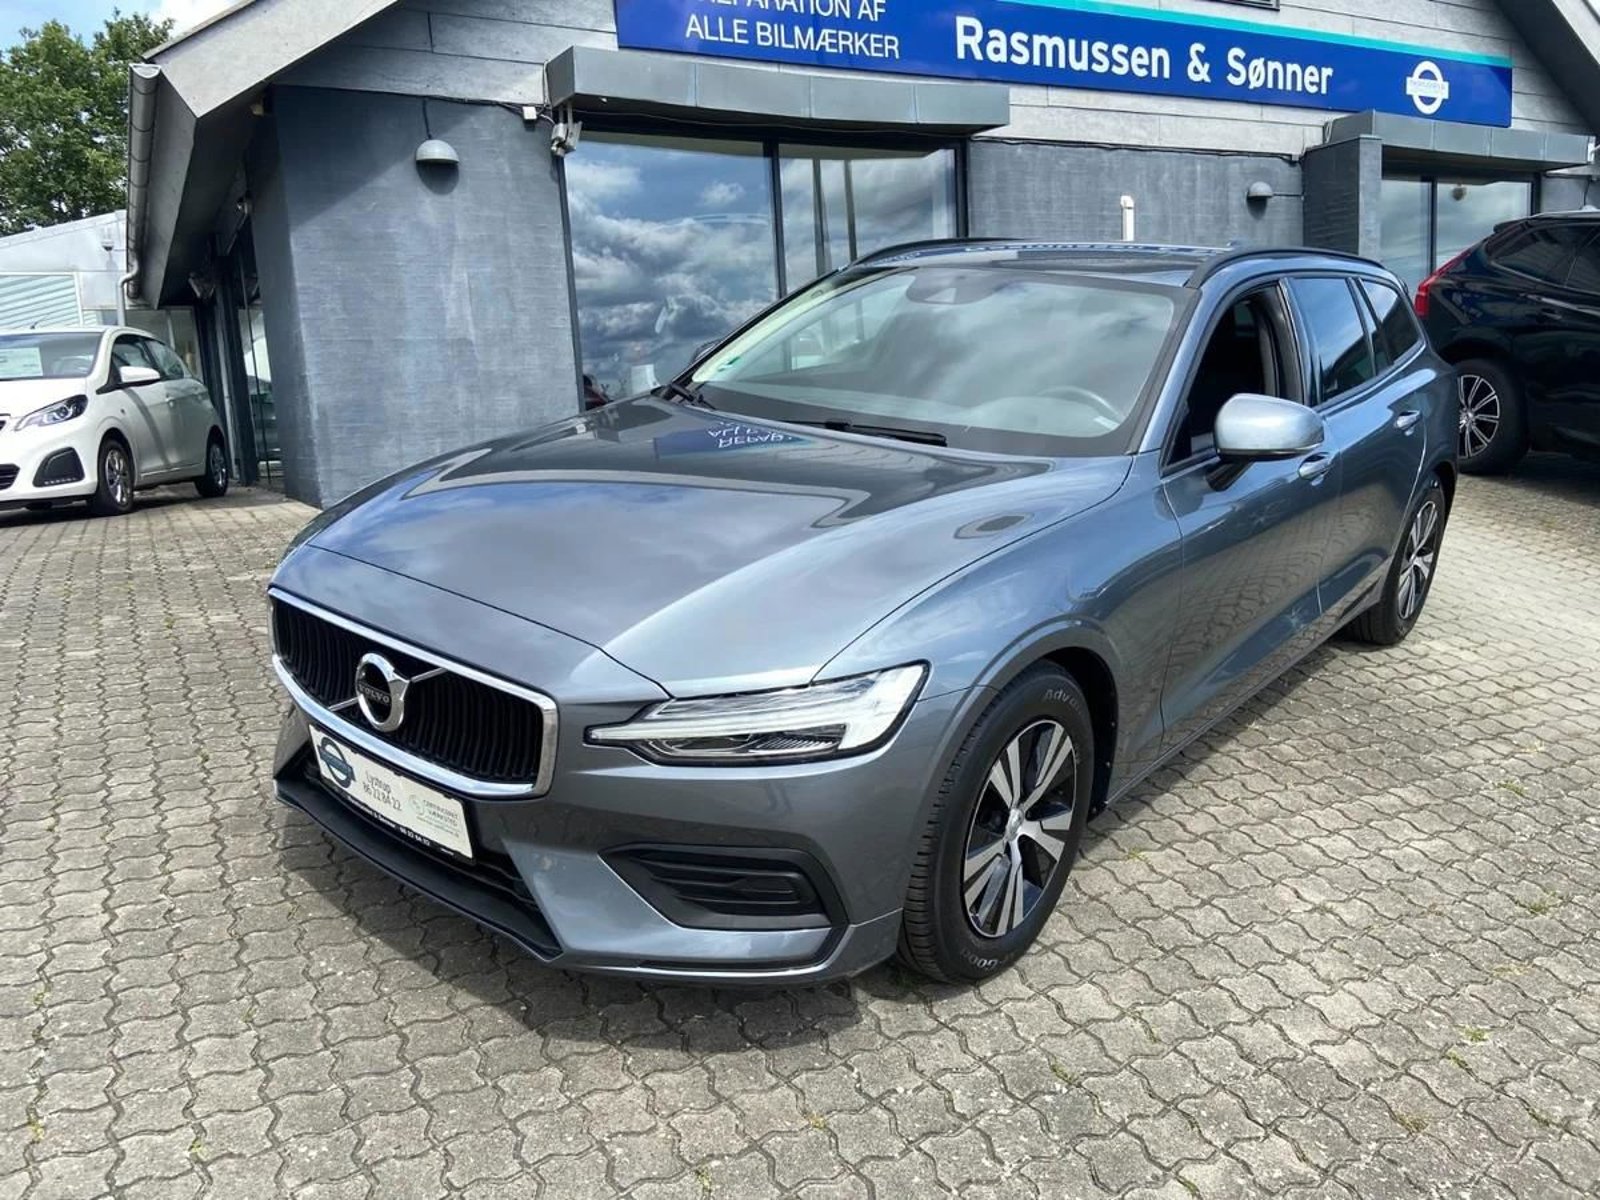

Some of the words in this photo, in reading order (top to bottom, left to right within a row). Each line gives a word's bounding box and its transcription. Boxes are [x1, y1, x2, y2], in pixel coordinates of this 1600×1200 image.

[700, 0, 851, 18] ATION
[857, 0, 886, 21] AF
[685, 14, 749, 44] ALLE
[756, 21, 900, 59] BILMÆRKER
[955, 16, 1170, 78] Rasmussen
[1187, 43, 1211, 83] &
[1227, 47, 1333, 94] Sønner
